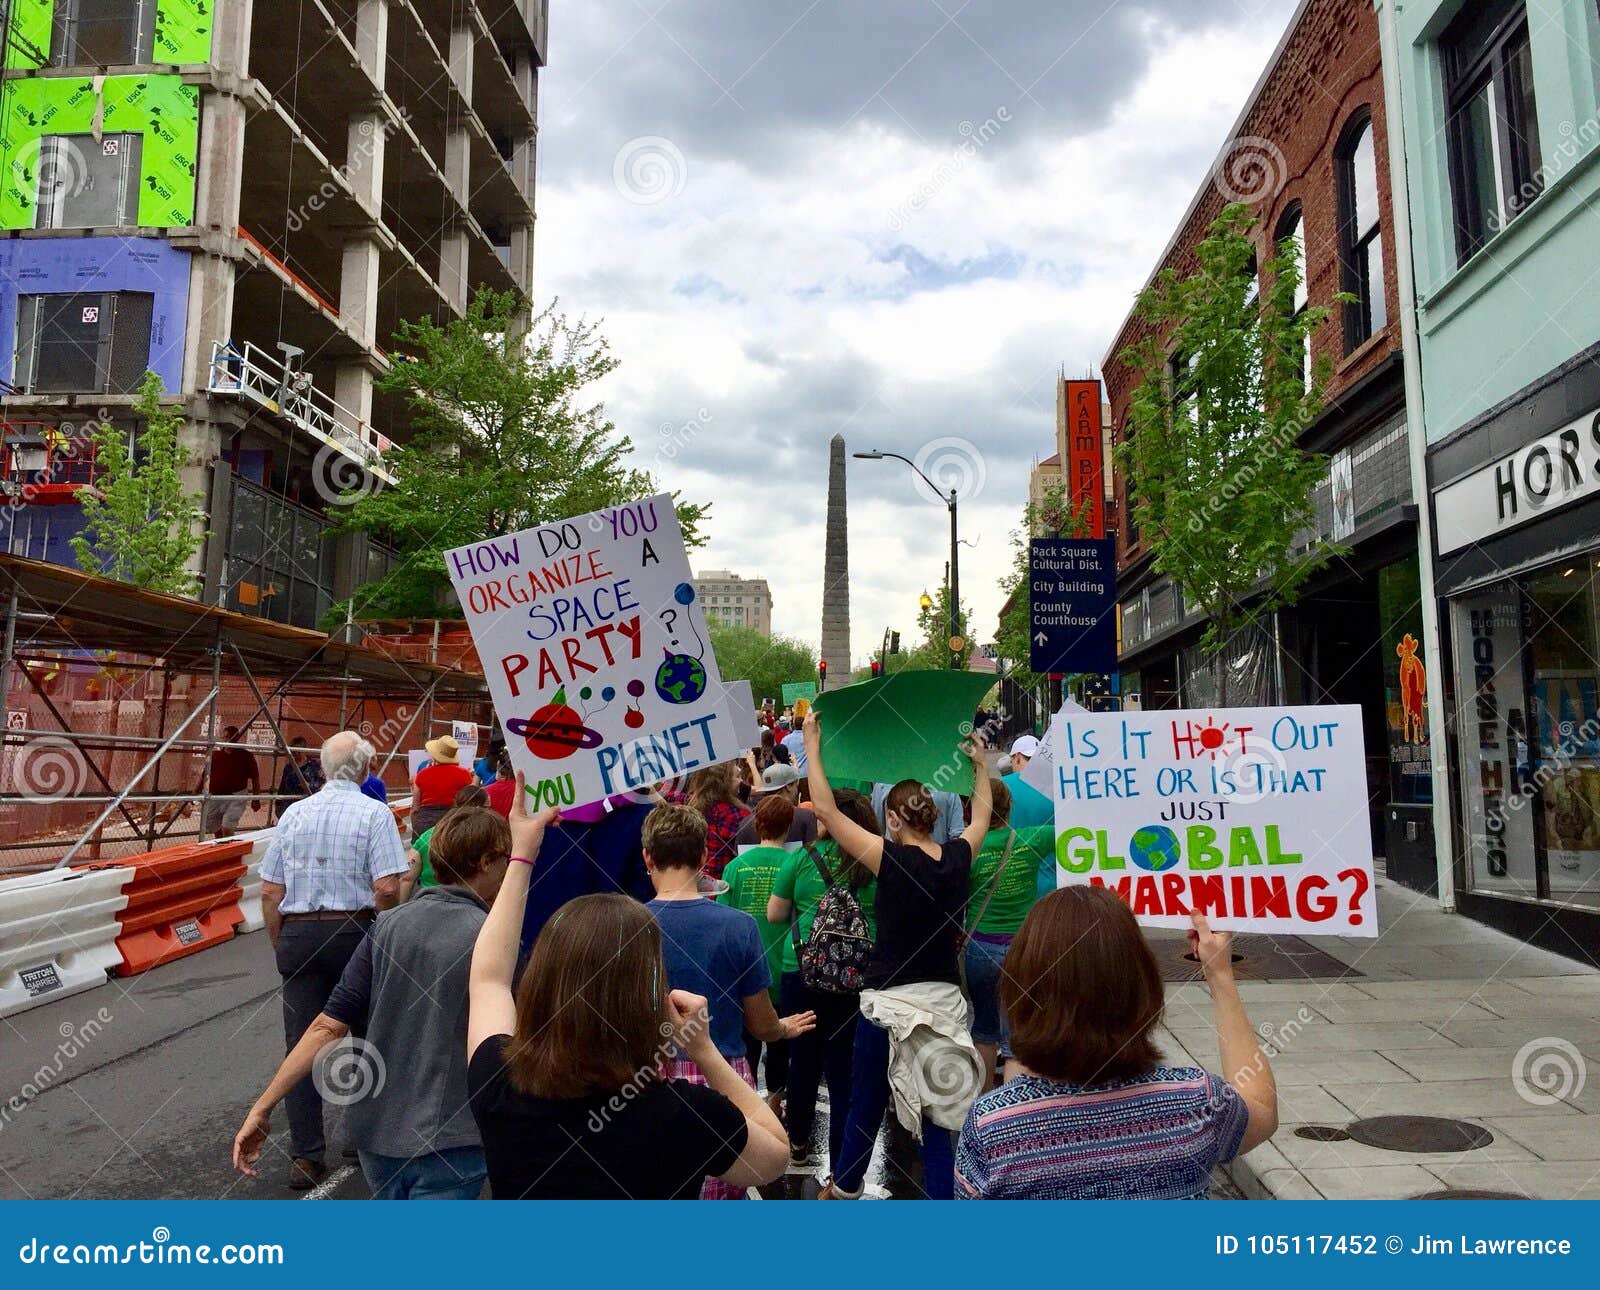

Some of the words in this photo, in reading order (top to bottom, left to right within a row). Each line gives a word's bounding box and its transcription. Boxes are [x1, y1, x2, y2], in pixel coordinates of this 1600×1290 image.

[163, 40, 178, 54] USG
[68, 91, 83, 106] USG
[127, 89, 141, 103] USG
[179, 85, 193, 99] USG
[44, 106, 58, 120] USG
[160, 130, 174, 144] USG
[175, 153, 190, 168] USG
[157, 186, 171, 201] USG
[171, 209, 186, 224] USG
[1076, 390, 1095, 451] FARM
[452, 538, 520, 580] HOW
[537, 523, 581, 559] DO
[600, 503, 658, 541] YOU
[1032, 546, 1057, 557] Pack
[1061, 547, 1097, 560] Square
[1033, 560, 1075, 570] Cultural
[1080, 560, 1102, 570] Dist.
[468, 550, 613, 615] ORGANIZE
[642, 538, 659, 567] A
[1033, 581, 1054, 594] City
[1058, 581, 1104, 595] Building
[527, 579, 640, 641] SPACE
[1033, 602, 1072, 615] County
[1034, 615, 1097, 626] Courthouse
[501, 615, 641, 697] PARTY
[1067, 722, 1100, 759] IS
[1121, 720, 1152, 760] IT
[1271, 716, 1340, 751] OUT
[524, 773, 576, 813] YOU
[597, 713, 717, 795] PLANET
[1059, 765, 1140, 800] HERE
[1156, 767, 1198, 797] OR
[1211, 766, 1236, 795] IS
[1246, 763, 1328, 794] THAT
[1160, 801, 1230, 822] JUST
[1055, 824, 1303, 874] GLOBAL
[22, 966, 54, 983] TRITON
[27, 975, 59, 990] BARRIER
